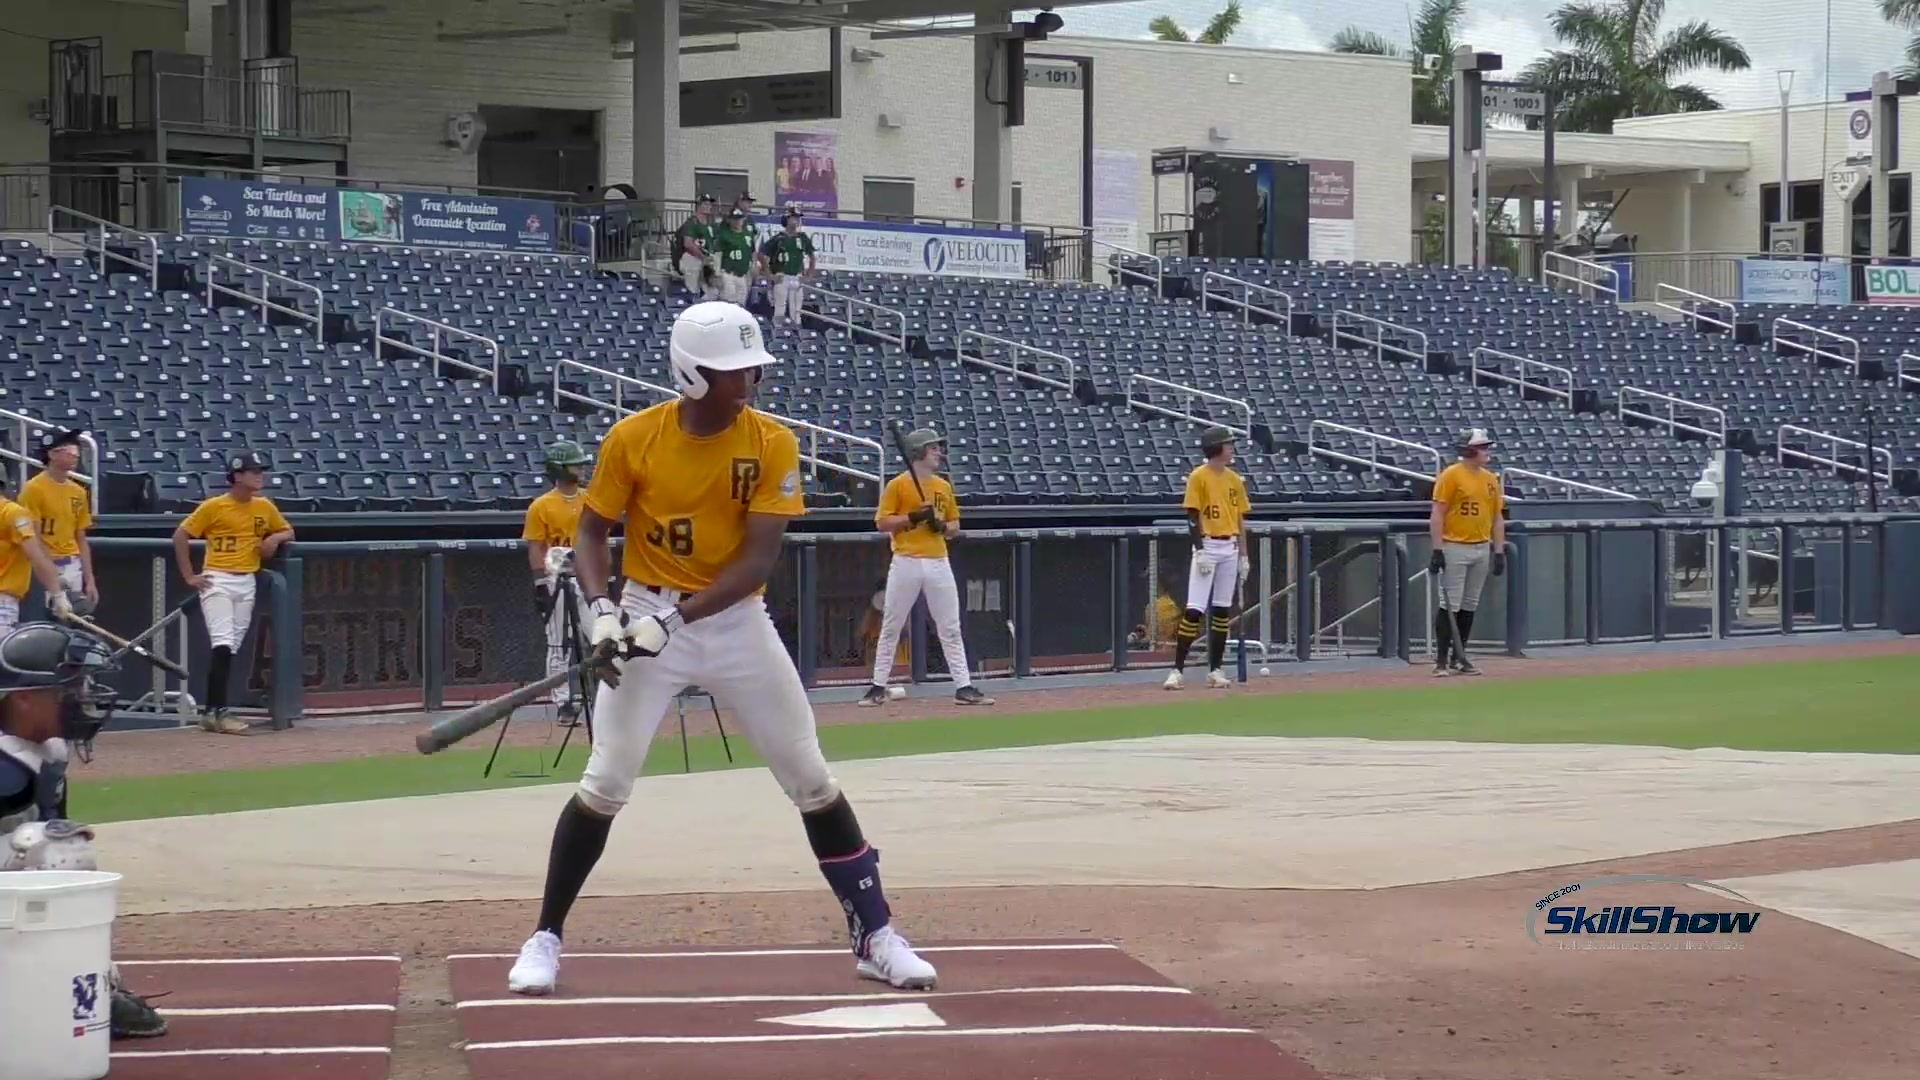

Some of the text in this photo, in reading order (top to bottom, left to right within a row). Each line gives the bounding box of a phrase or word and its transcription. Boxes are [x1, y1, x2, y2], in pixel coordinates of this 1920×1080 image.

[1832, 171, 1855, 183] EXIT
[243, 186, 326, 204] Sea Turtles and
[245, 204, 260, 217] So
[262, 205, 292, 219] Much
[293, 207, 326, 221] More!
[421, 198, 498, 215] Free Admission
[412, 214, 506, 233] Oceanside Location
[811, 232, 847, 253] CITY
[945, 240, 1020, 263] VELOCITY
[1867, 268, 1920, 293] BOL
[1203, 505, 1220, 519] 46
[1460, 502, 1479, 516] 55
[213, 536, 237, 553] 32
[247, 608, 486, 691] ASTRS
